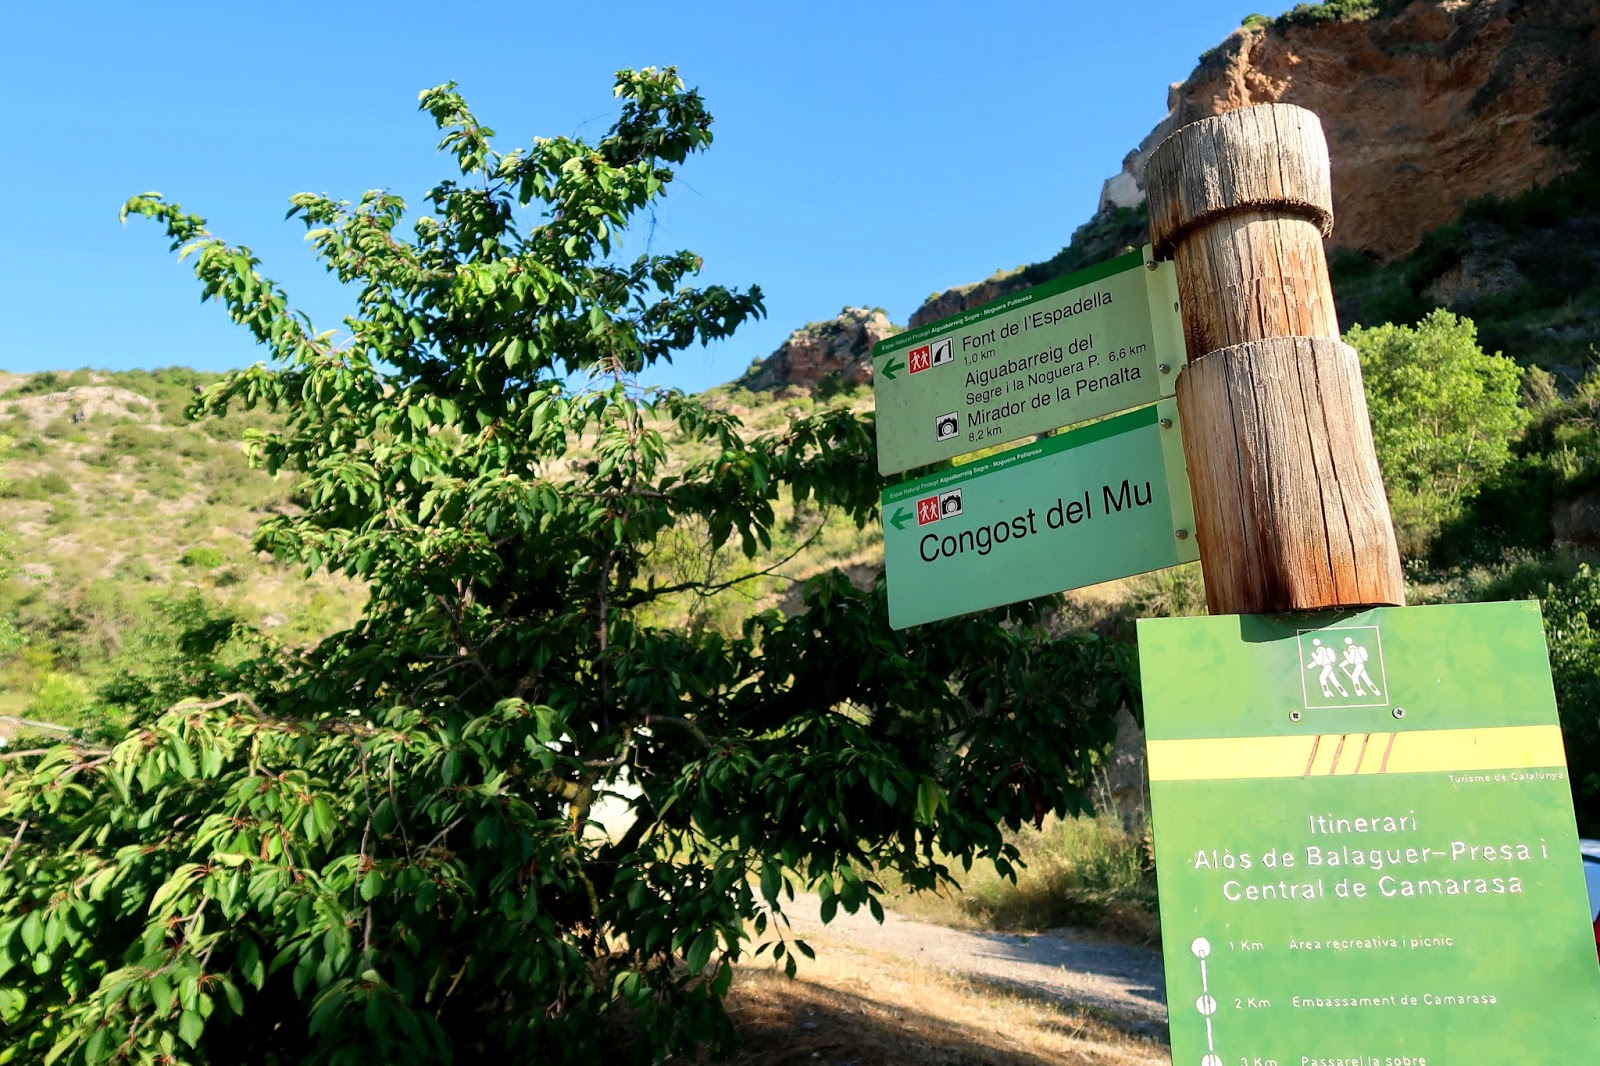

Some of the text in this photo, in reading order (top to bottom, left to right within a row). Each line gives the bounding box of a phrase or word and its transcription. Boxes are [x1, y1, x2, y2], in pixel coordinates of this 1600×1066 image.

[895, 334, 912, 347] Natural
[912, 329, 931, 342] Protegit
[931, 317, 964, 334] Aiguabarreig
[964, 312, 980, 322] Segre
[983, 303, 1007, 316] Noguera
[962, 291, 1113, 352] Font de l'Espadella
[963, 348, 996, 367] 1,0 km
[965, 334, 1094, 388] Aiguabarreig del
[966, 342, 1147, 406] Segre i la Noguera P. 6,6 km
[968, 366, 1142, 428] Mirador de la Penalta
[968, 425, 1002, 443] 8,2 km
[903, 484, 921, 495] Natural
[920, 479, 939, 491] Protegit
[939, 469, 973, 483] Aiguabarreig
[973, 463, 989, 474] Segre
[993, 456, 1016, 468] Noguera
[919, 479, 1153, 562] Congost del Mu
[1449, 771, 1564, 783] Turisme de Catalunya
[1309, 810, 1417, 834] Itinerari
[1194, 848, 1252, 870] Alòs
[1262, 848, 1295, 868] de
[1540, 838, 1548, 859] i
[1223, 875, 1523, 901] Central de Camarasa
[1229, 935, 1453, 950] 1 Km Àrea recreativa i picnic
[1234, 993, 1497, 1009] 2 Km Embassament de Camarasa
[1240, 1057, 1248, 1066] 3
[1253, 1057, 1278, 1066] Km
[1385, 1055, 1427, 1066] sobre
